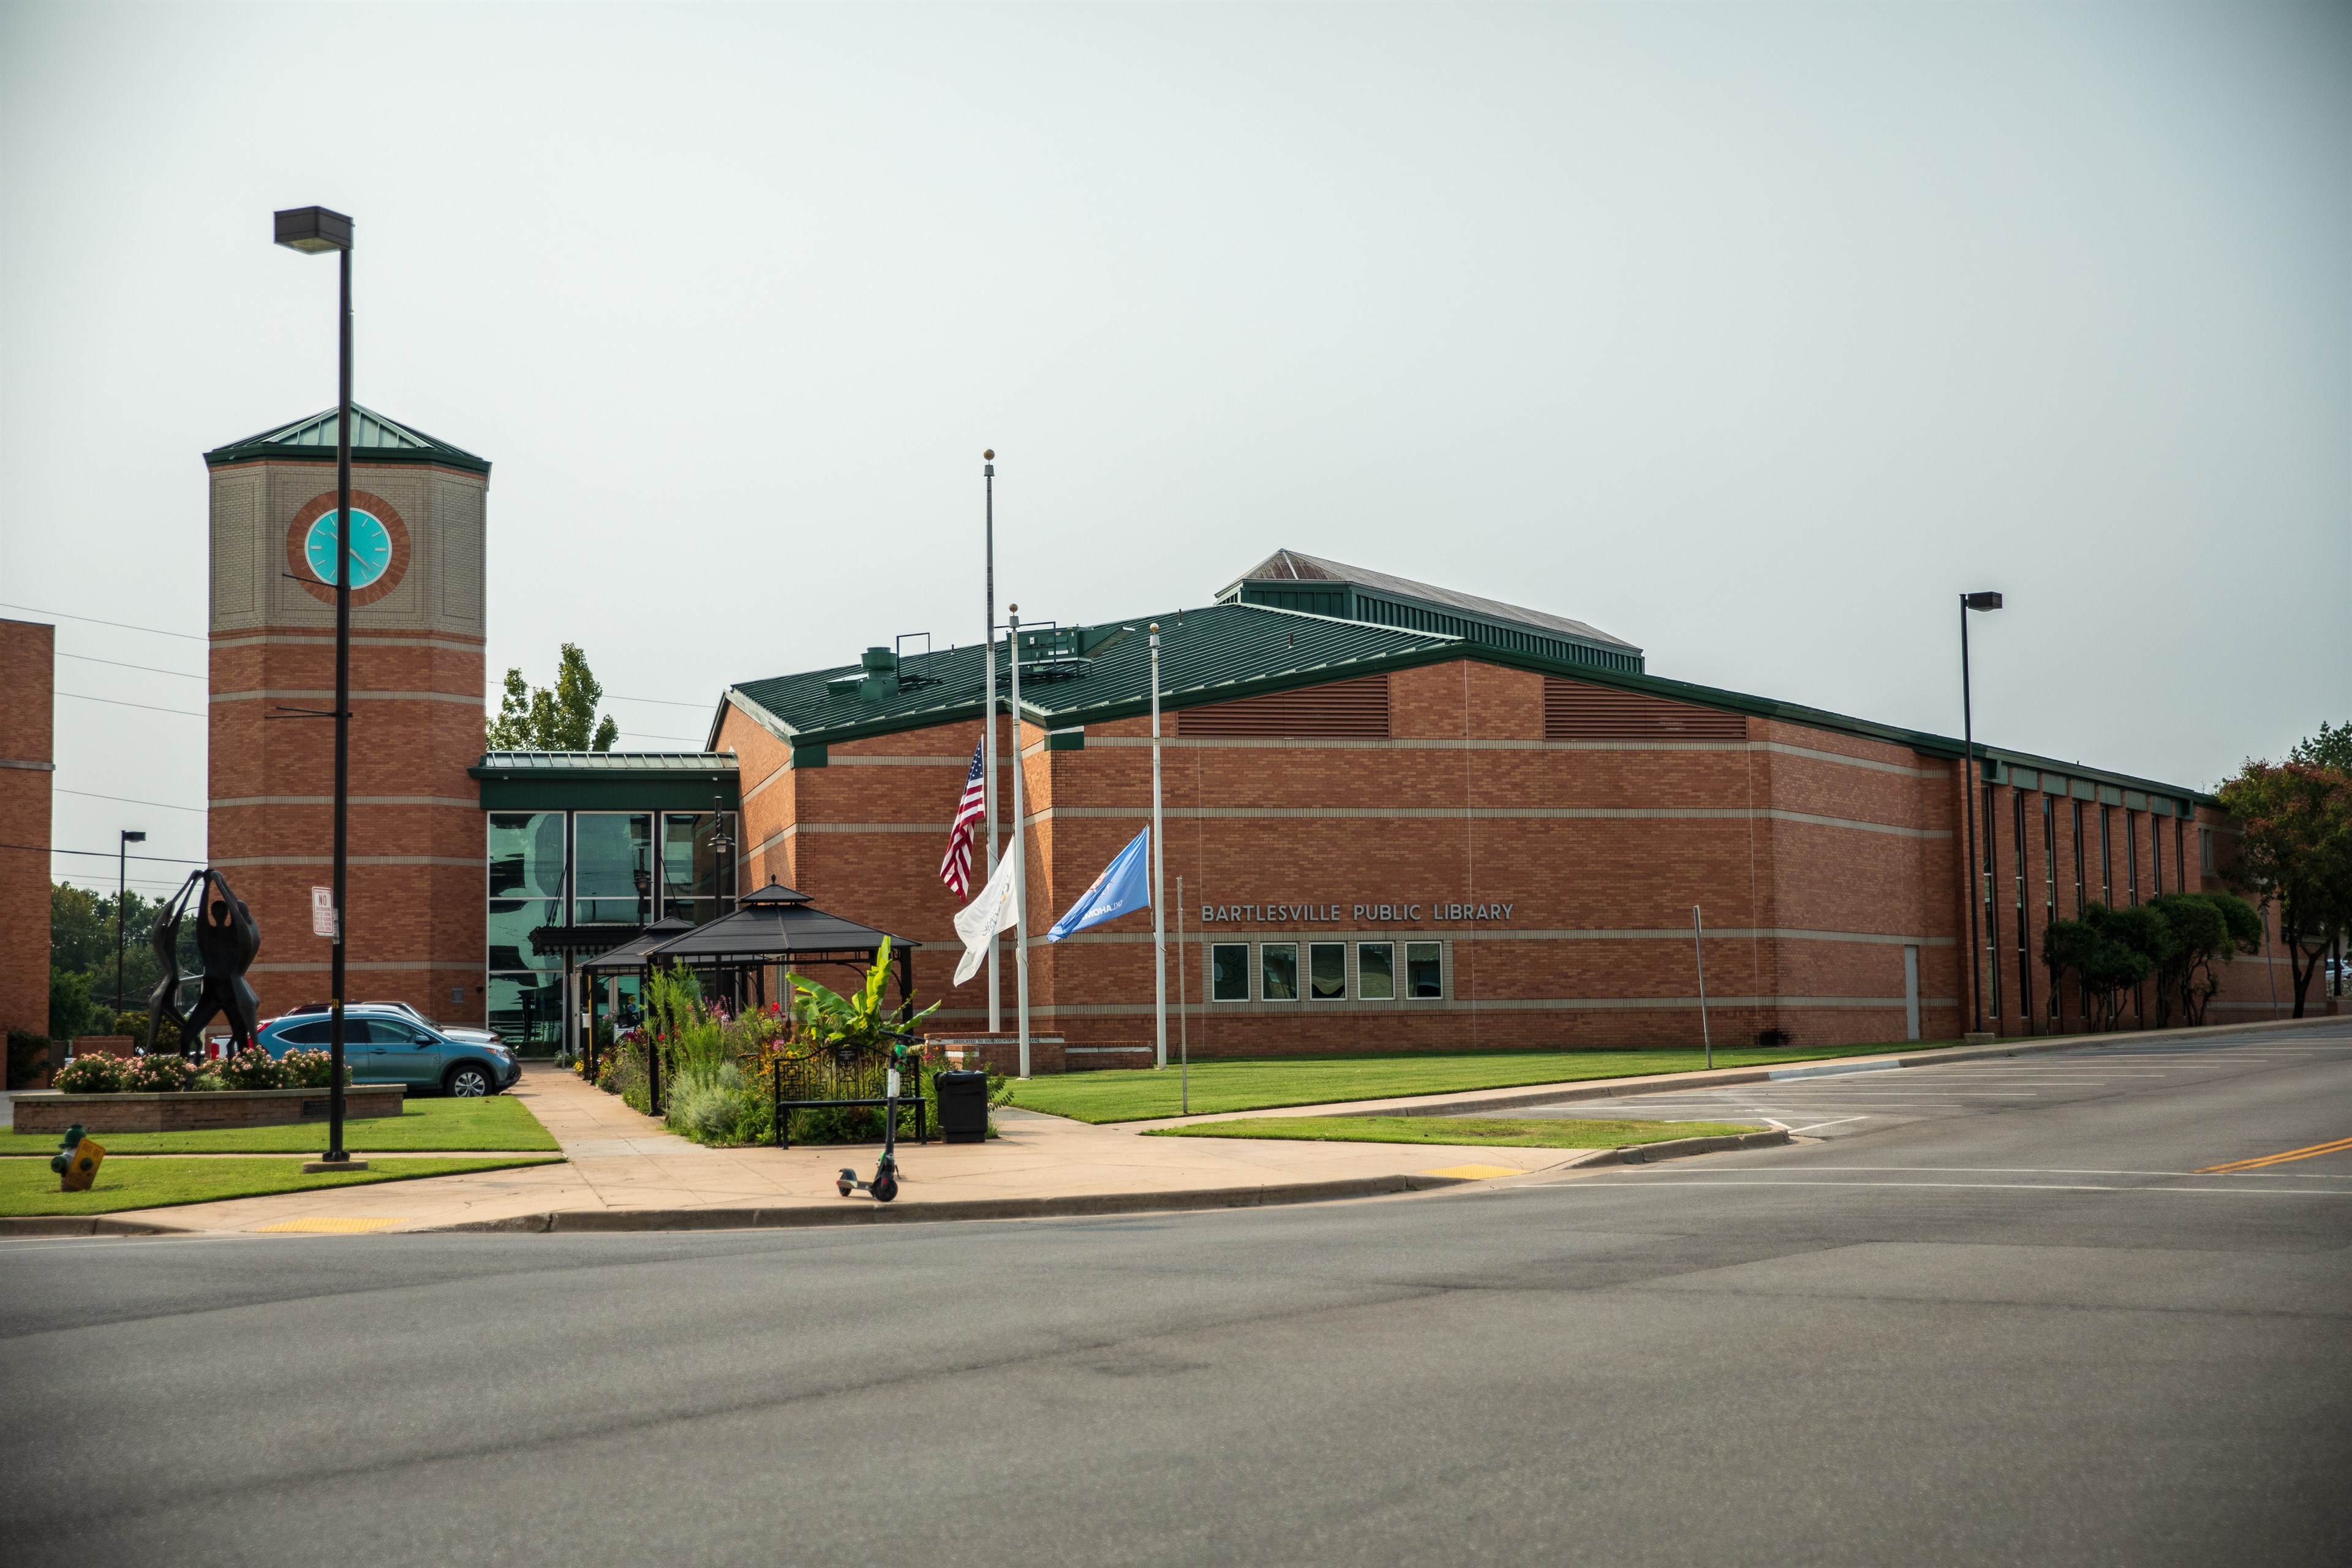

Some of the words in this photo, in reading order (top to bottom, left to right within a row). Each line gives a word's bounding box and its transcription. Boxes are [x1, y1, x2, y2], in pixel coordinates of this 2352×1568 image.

[319, 895, 326, 906] NO
[1202, 905, 1340, 921] BARTLESVILLE
[1353, 904, 1421, 921] PUBLIC
[1433, 903, 1513, 920] LIBRARY
[82, 1144, 92, 1153] OUT
